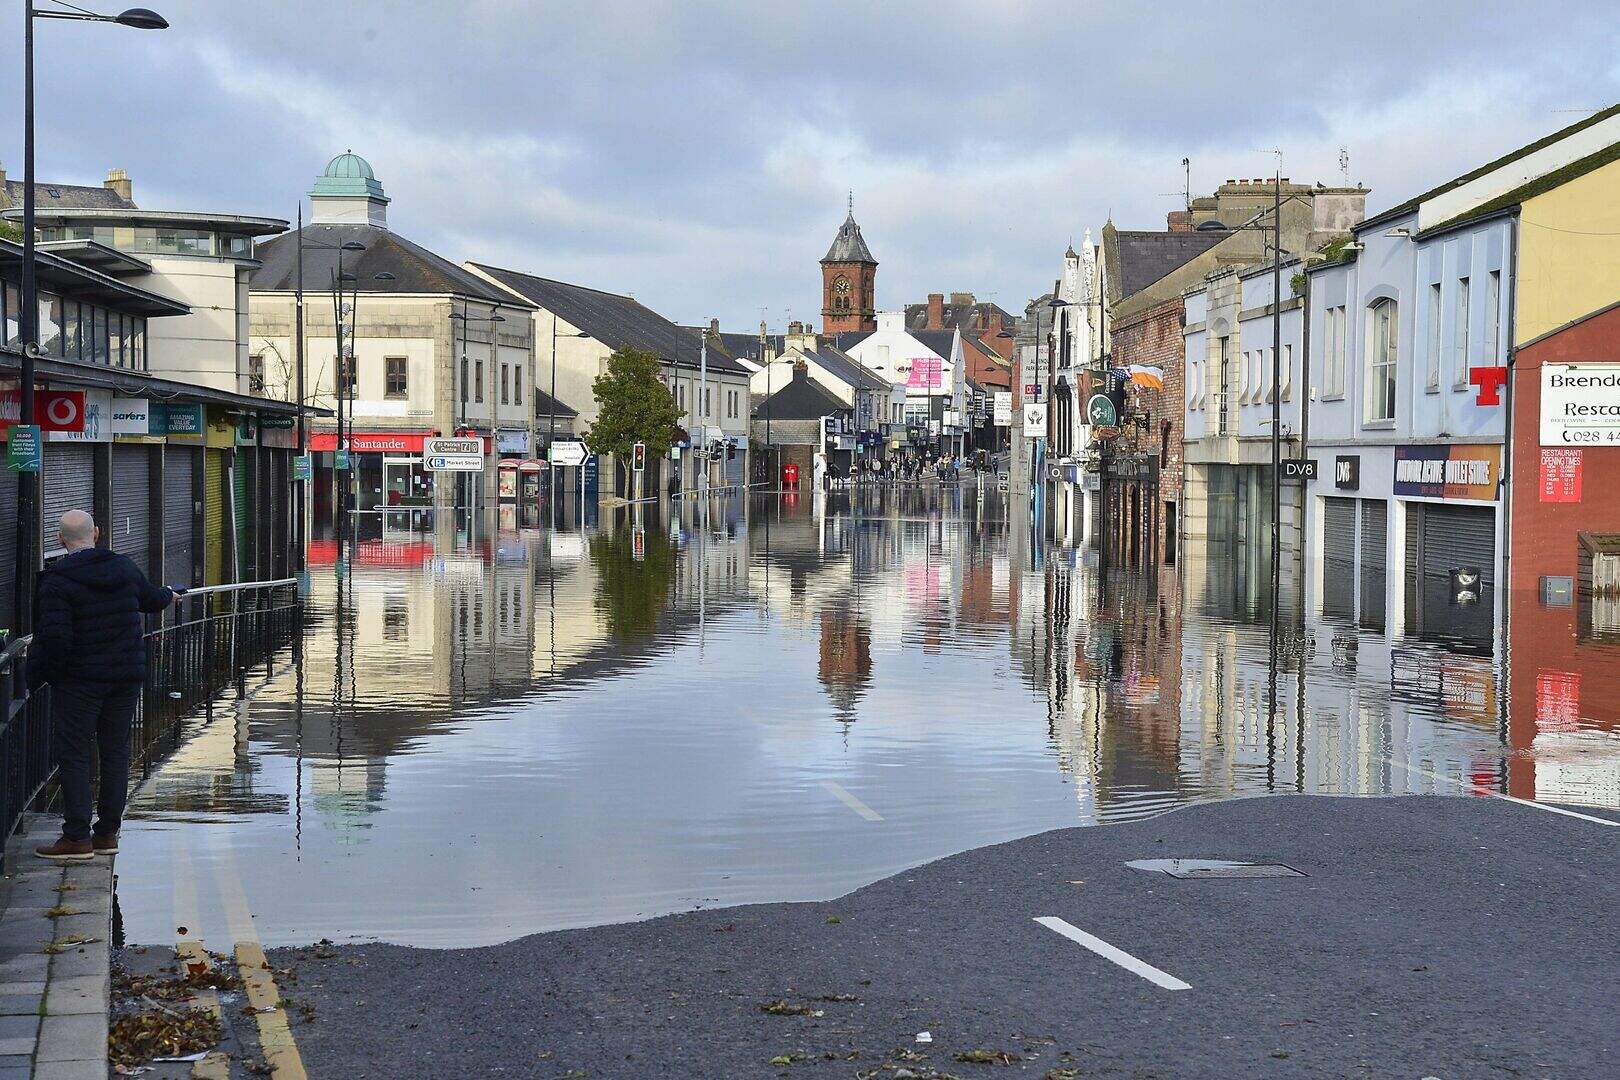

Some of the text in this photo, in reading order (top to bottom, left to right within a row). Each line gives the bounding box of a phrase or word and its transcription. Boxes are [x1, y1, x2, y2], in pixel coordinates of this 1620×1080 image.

[112, 411, 146, 421] savers
[1573, 431, 1600, 442] 028
[353, 437, 406, 449] Santander
[1541, 449, 1582, 457] RESTAURANT
[1565, 456, 1581, 466] TIMES
[1286, 463, 1313, 475] DV8
[1337, 461, 1350, 483] DV8
[1396, 459, 1490, 485] OUTDOOR ACTIVE OUTLET STORE
